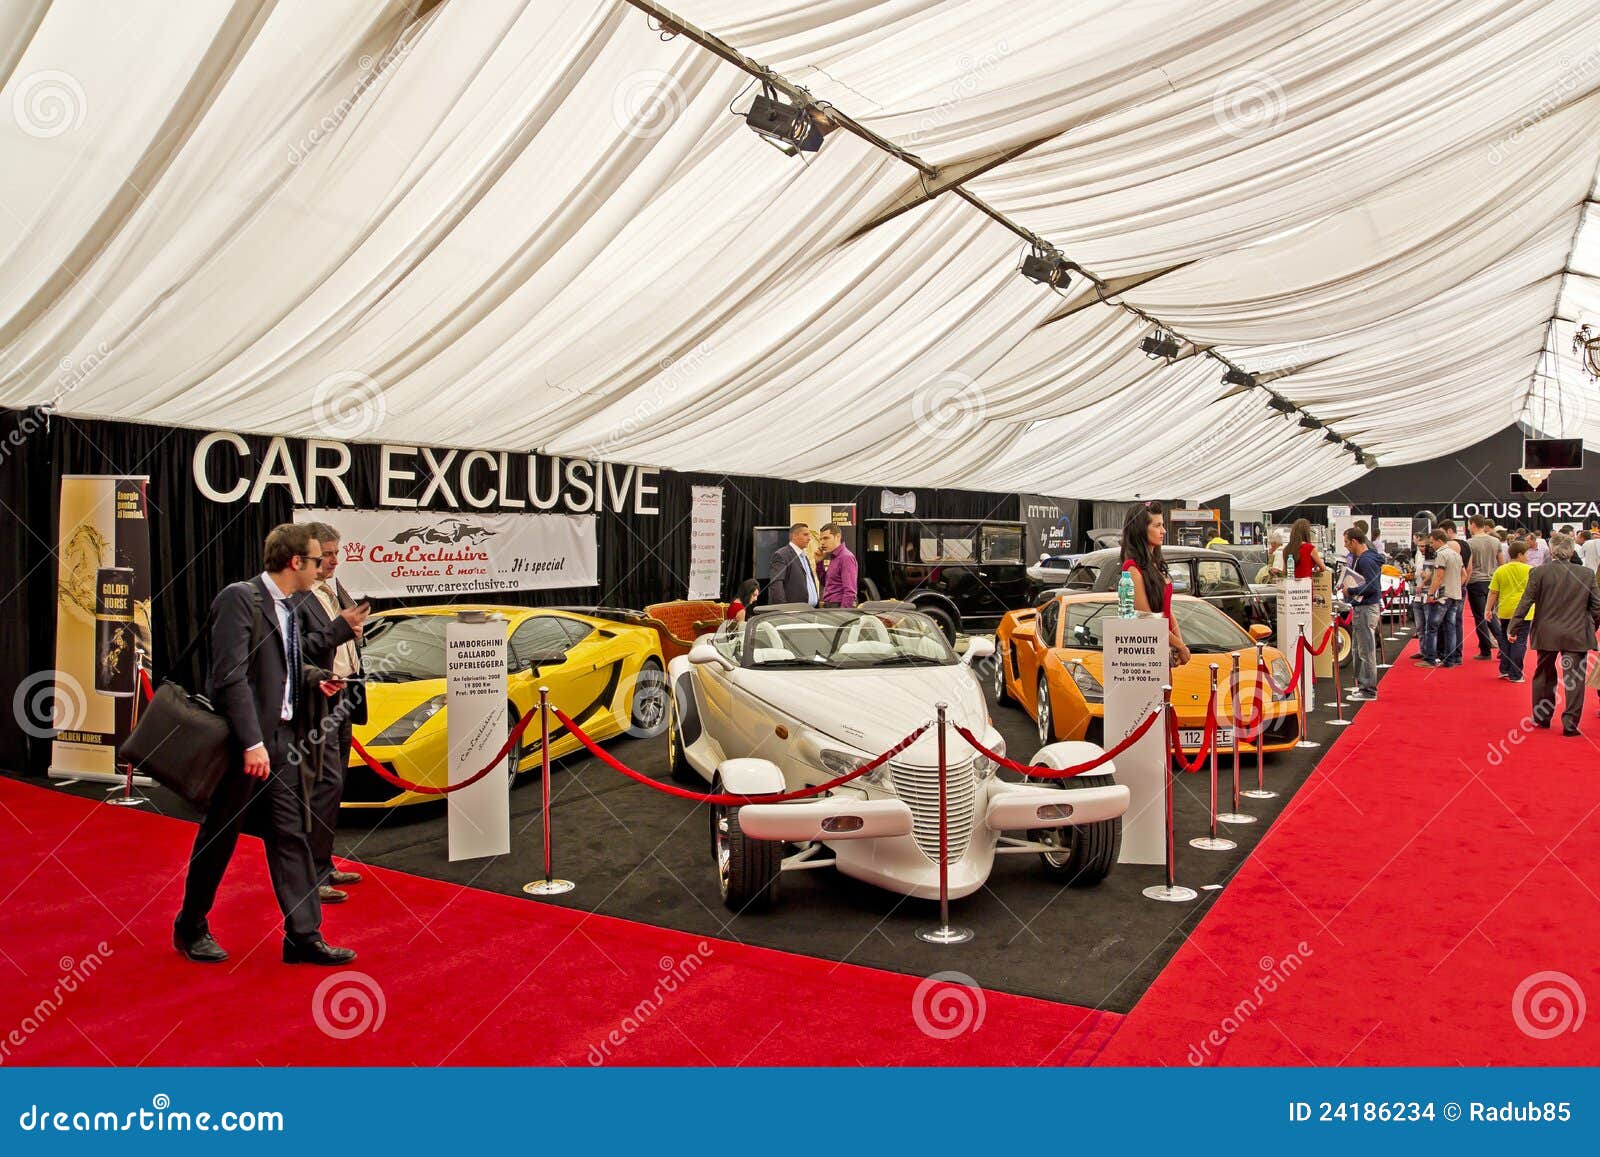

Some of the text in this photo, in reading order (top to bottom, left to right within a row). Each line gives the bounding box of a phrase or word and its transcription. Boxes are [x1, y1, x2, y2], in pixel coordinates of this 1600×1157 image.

[192, 431, 661, 515] CAR EXCLUSIVE
[1452, 502, 1600, 518] LOTUS FORZA
[369, 545, 489, 563] CarExclusive
[391, 564, 487, 578] Service & more
[511, 558, 530, 573] It's
[531, 557, 565, 575] special
[102, 583, 129, 595] GOLDEN
[406, 578, 519, 594] www.carexclusive.ro
[104, 597, 128, 609] HORSE
[449, 638, 503, 649] LAMBORGHINI
[1115, 635, 1159, 644] PLYMOUTH
[457, 649, 496, 659] GALLARDO
[1117, 647, 1156, 655] PROWLER
[448, 659, 505, 670] SUPERLEGGERA
[1185, 732, 1201, 744] 112
